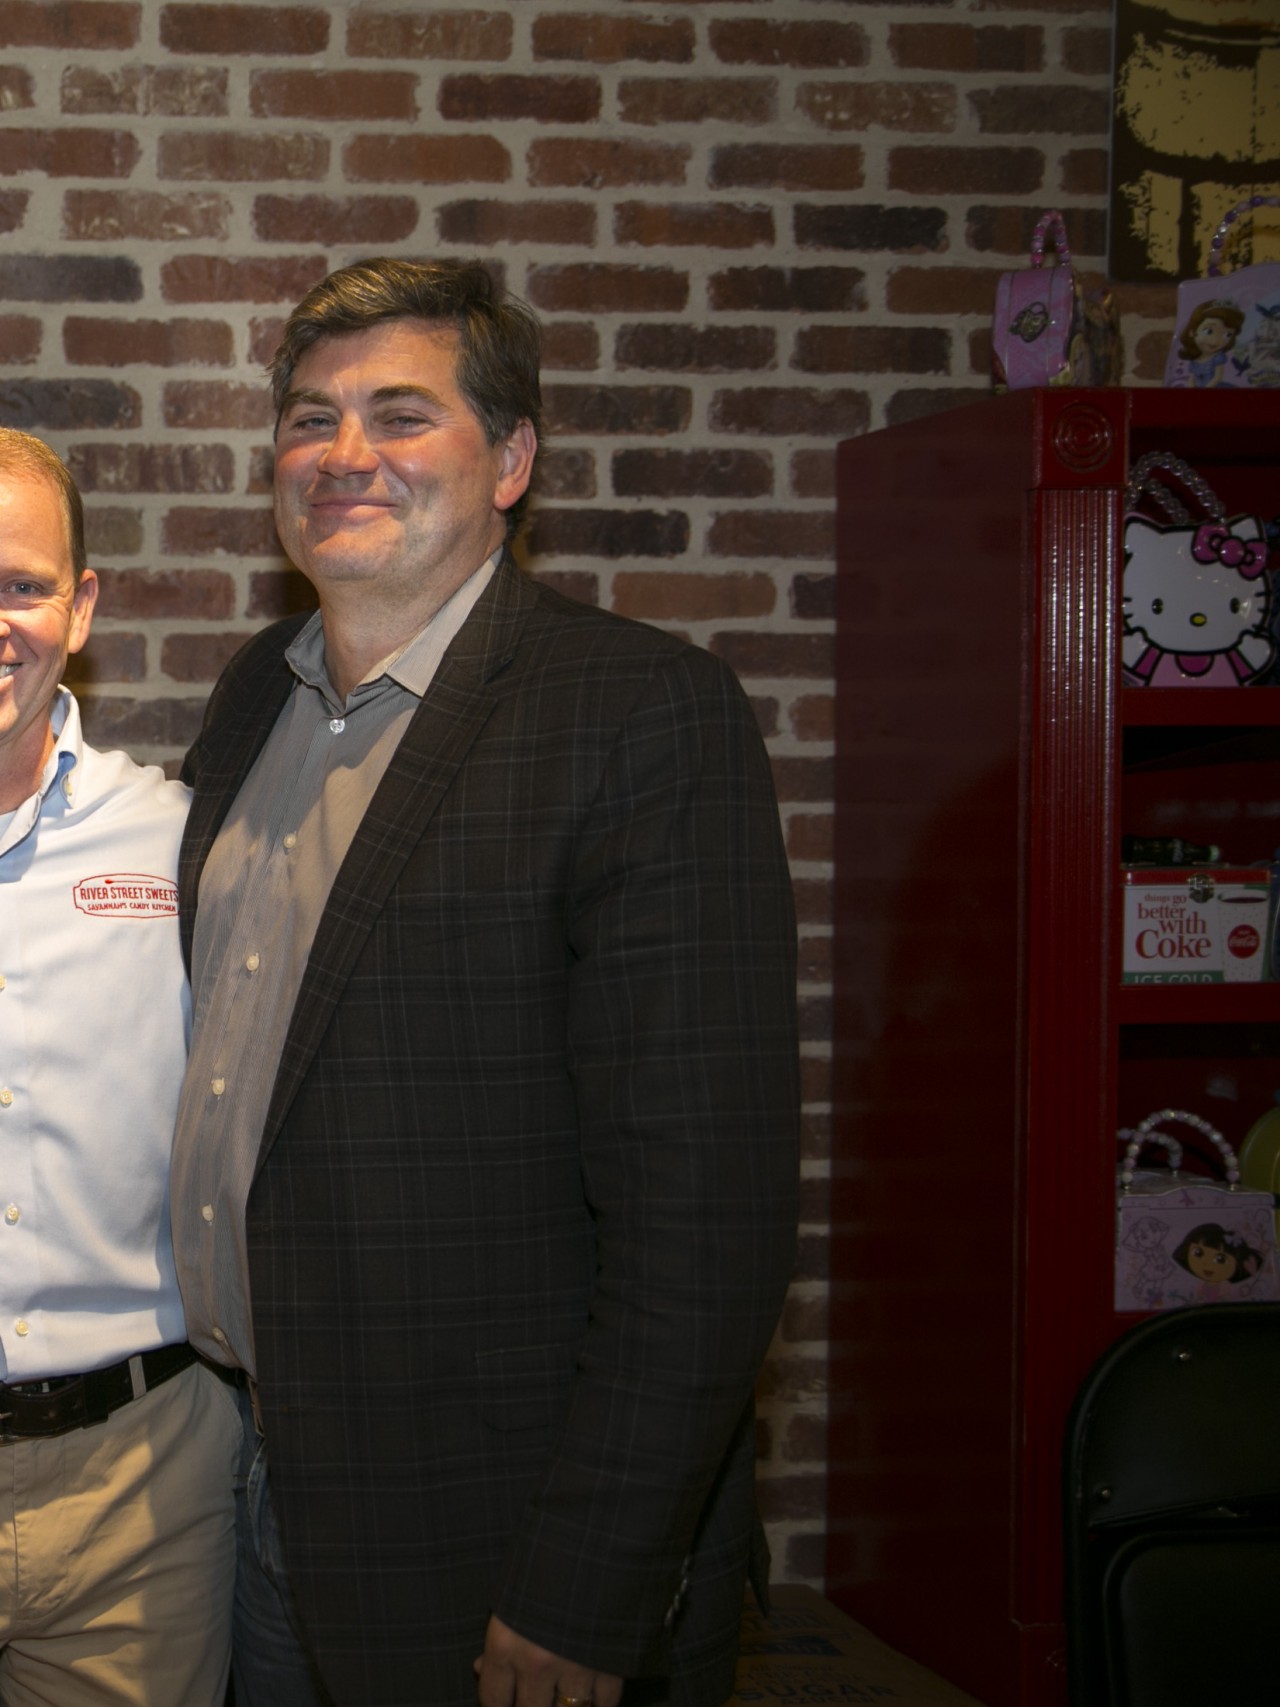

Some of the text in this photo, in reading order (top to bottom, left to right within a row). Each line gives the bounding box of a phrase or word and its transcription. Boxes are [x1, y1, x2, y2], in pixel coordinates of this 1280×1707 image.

[81, 887, 179, 902] RIVER STREET SWEETS
[1144, 893, 1187, 905] things go
[88, 902, 176, 912] SAVANNAH'S CANDY KITCHEN
[1137, 903, 1186, 919] better
[1159, 912, 1206, 934] with
[1136, 929, 1211, 959] Coke
[736, 1684, 896, 1701] SUGAR
